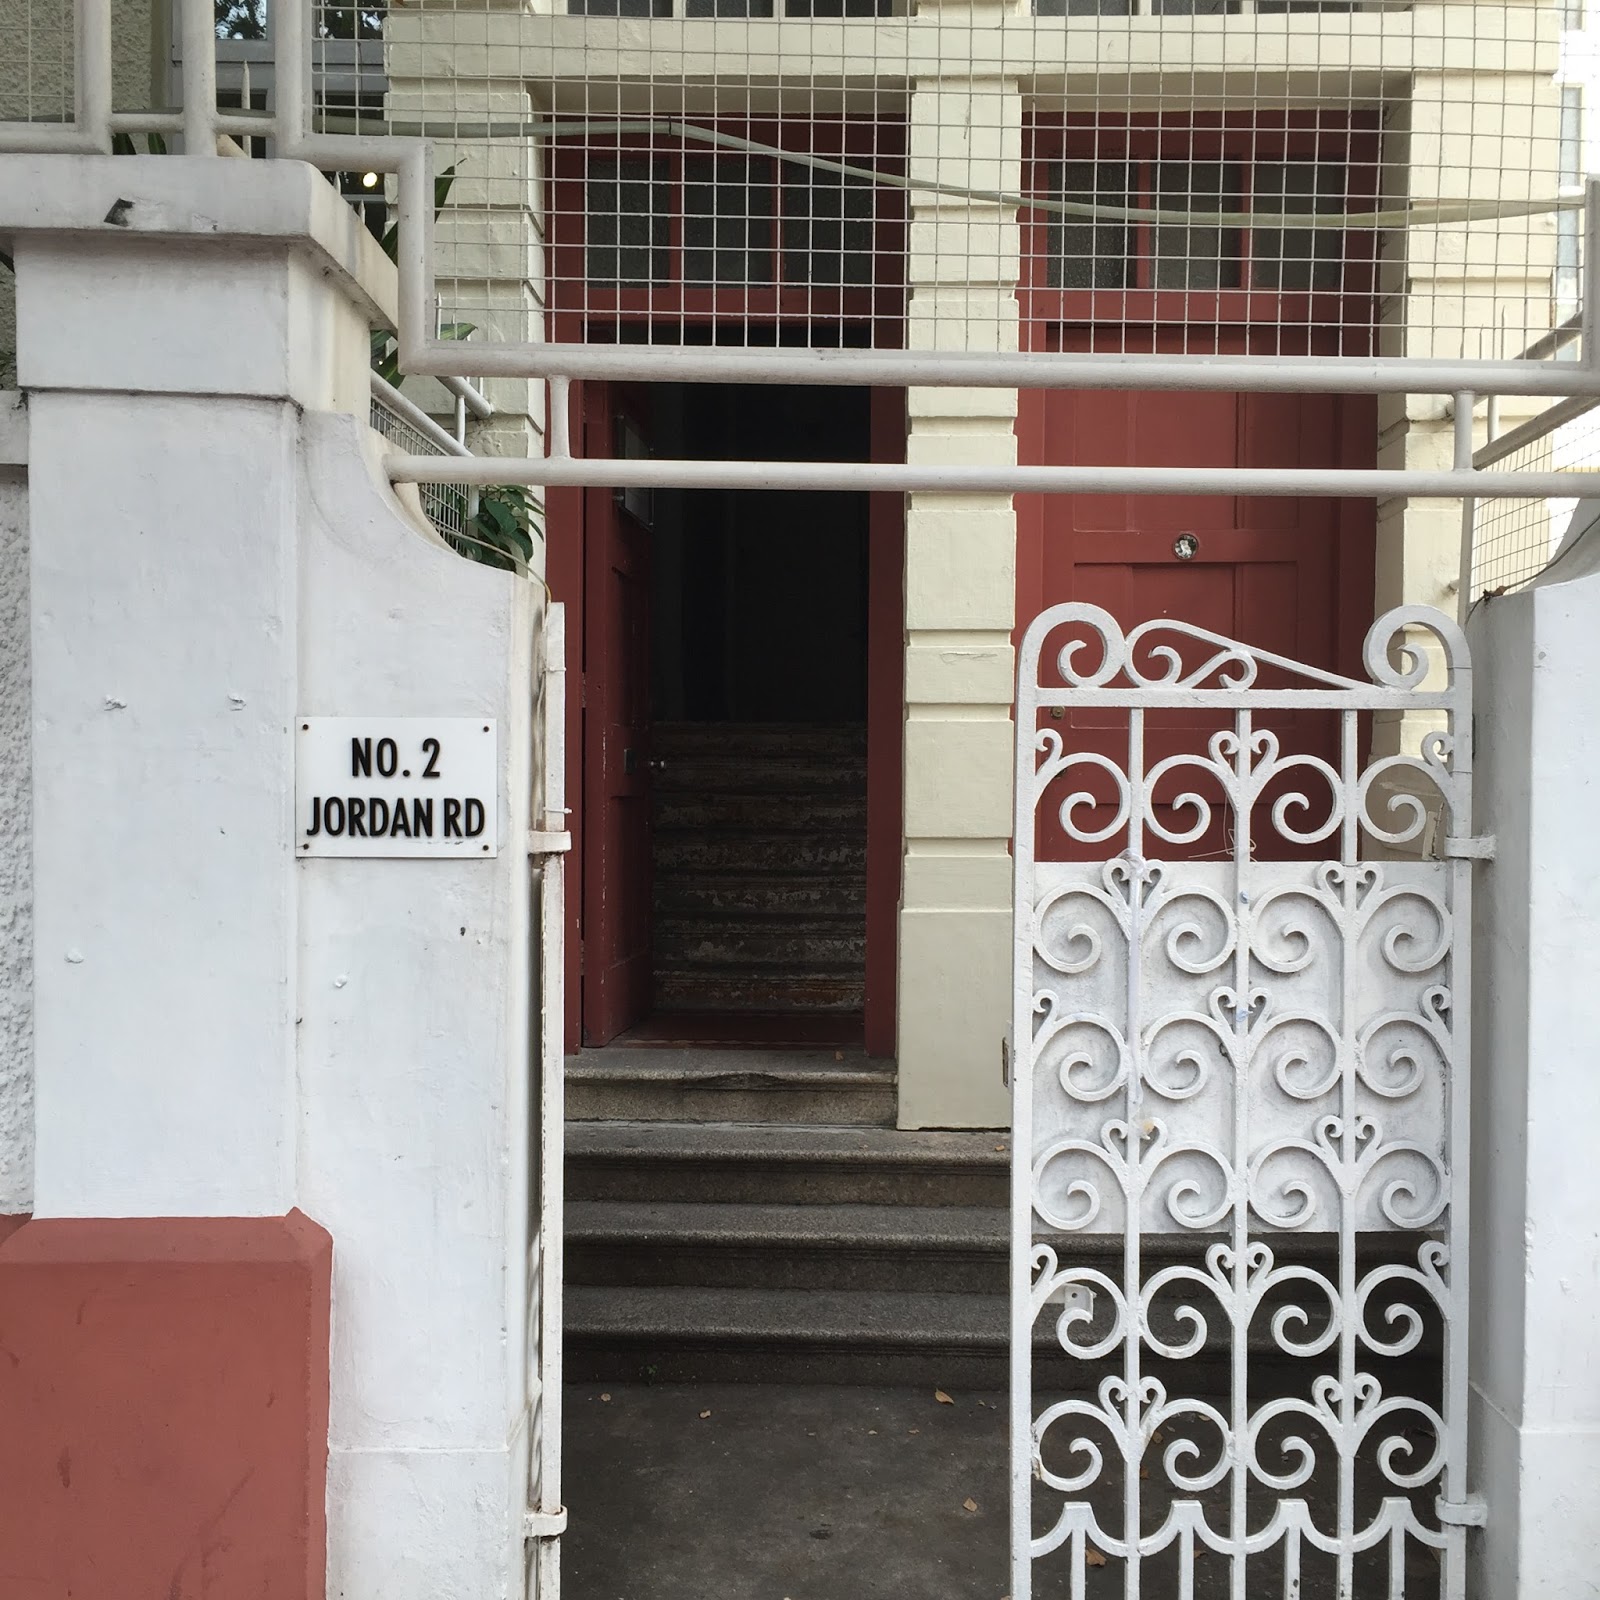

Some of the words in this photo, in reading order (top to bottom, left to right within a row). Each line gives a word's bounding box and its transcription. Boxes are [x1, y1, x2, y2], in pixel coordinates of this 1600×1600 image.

[351, 737, 411, 778] NO.
[422, 737, 441, 778] 2
[306, 796, 433, 838] JORDAN
[443, 797, 485, 838] RD
